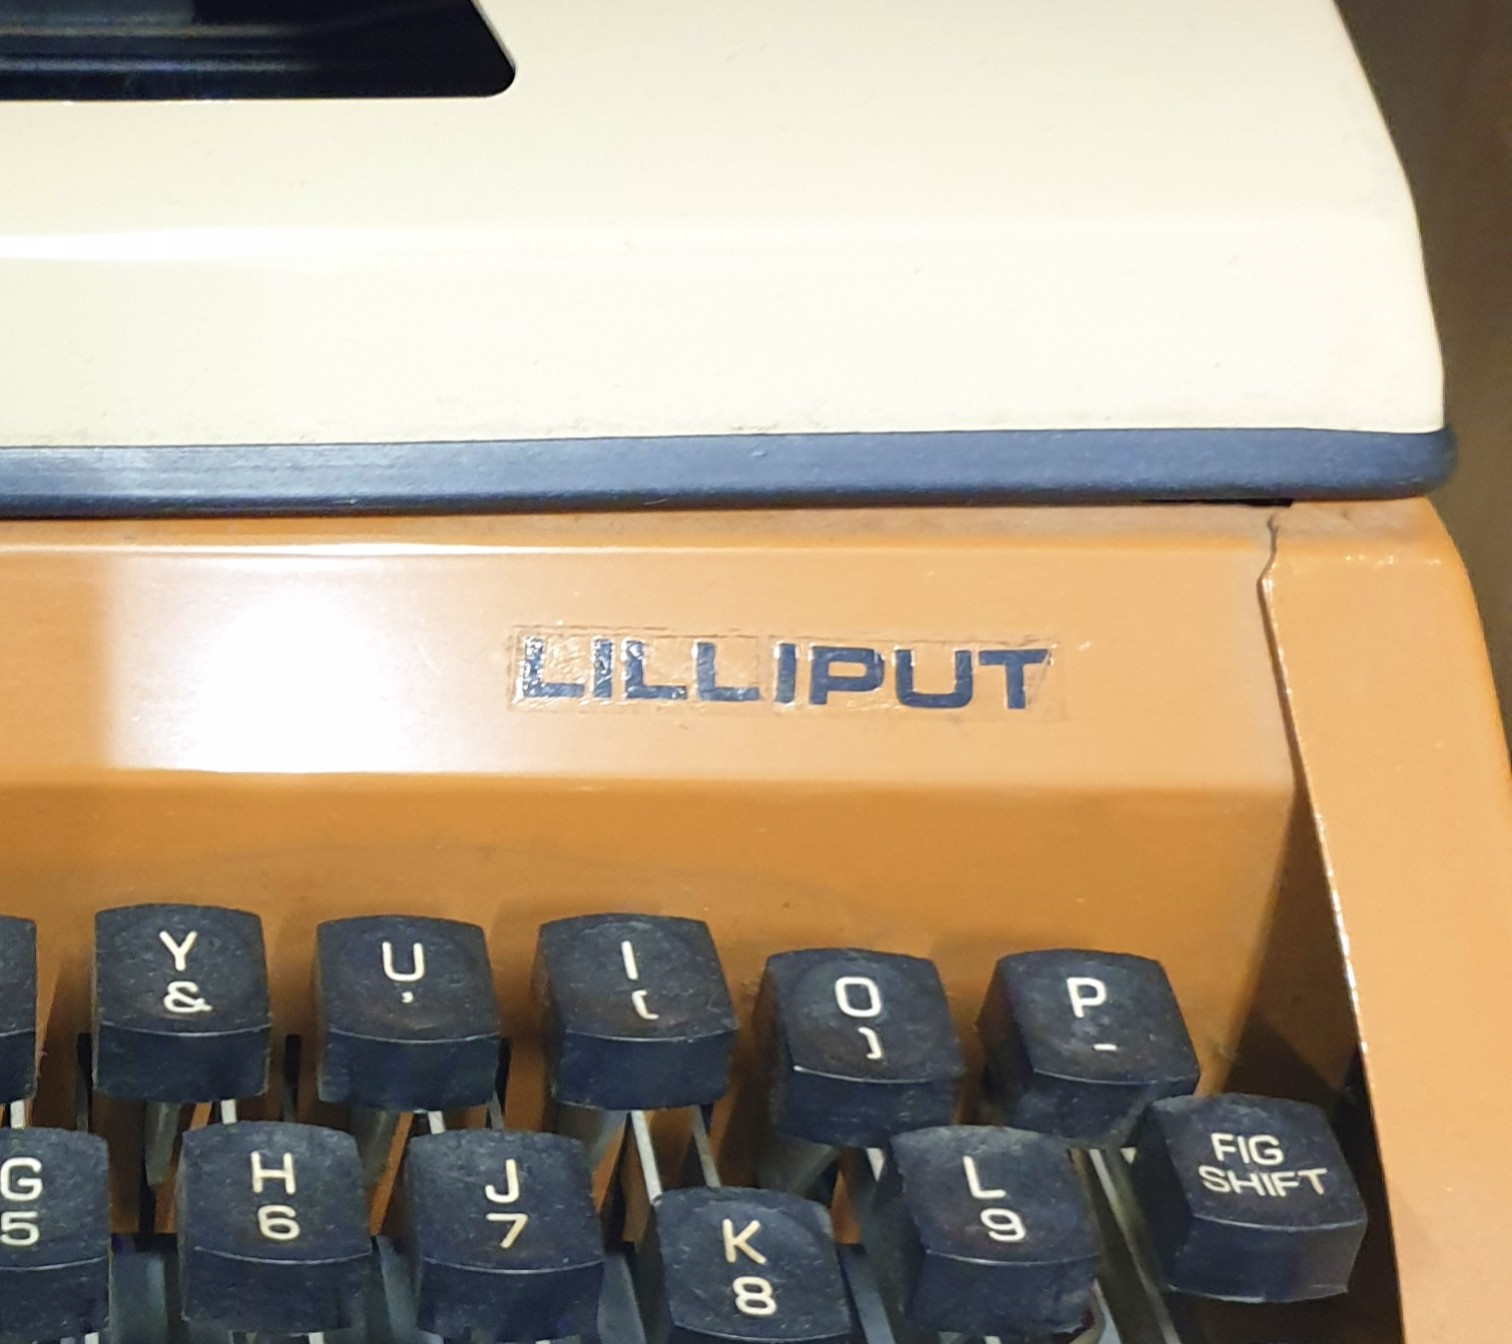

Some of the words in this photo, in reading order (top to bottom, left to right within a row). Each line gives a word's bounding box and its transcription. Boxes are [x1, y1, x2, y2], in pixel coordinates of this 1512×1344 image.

[518, 637, 1050, 709] LILLIPUT
[159, 931, 197, 972] Y
[382, 941, 425, 982] U
[621, 940, 639, 980] I
[163, 981, 212, 1013] &
[834, 976, 882, 1018] O
[1066, 976, 1107, 1018] P
[1210, 1132, 1285, 1166] FIG
[0, 1157, 43, 1202] G
[250, 1150, 296, 1195] H
[484, 1158, 520, 1204] J
[962, 1155, 1007, 1199] L
[1197, 1163, 1329, 1199] SHIFT
[0, 1210, 40, 1246] 5
[258, 1204, 300, 1241] 6
[486, 1212, 528, 1249] 7
[722, 1218, 767, 1264] K
[980, 1208, 1026, 1242] 9
[732, 1276, 777, 1316] 8
